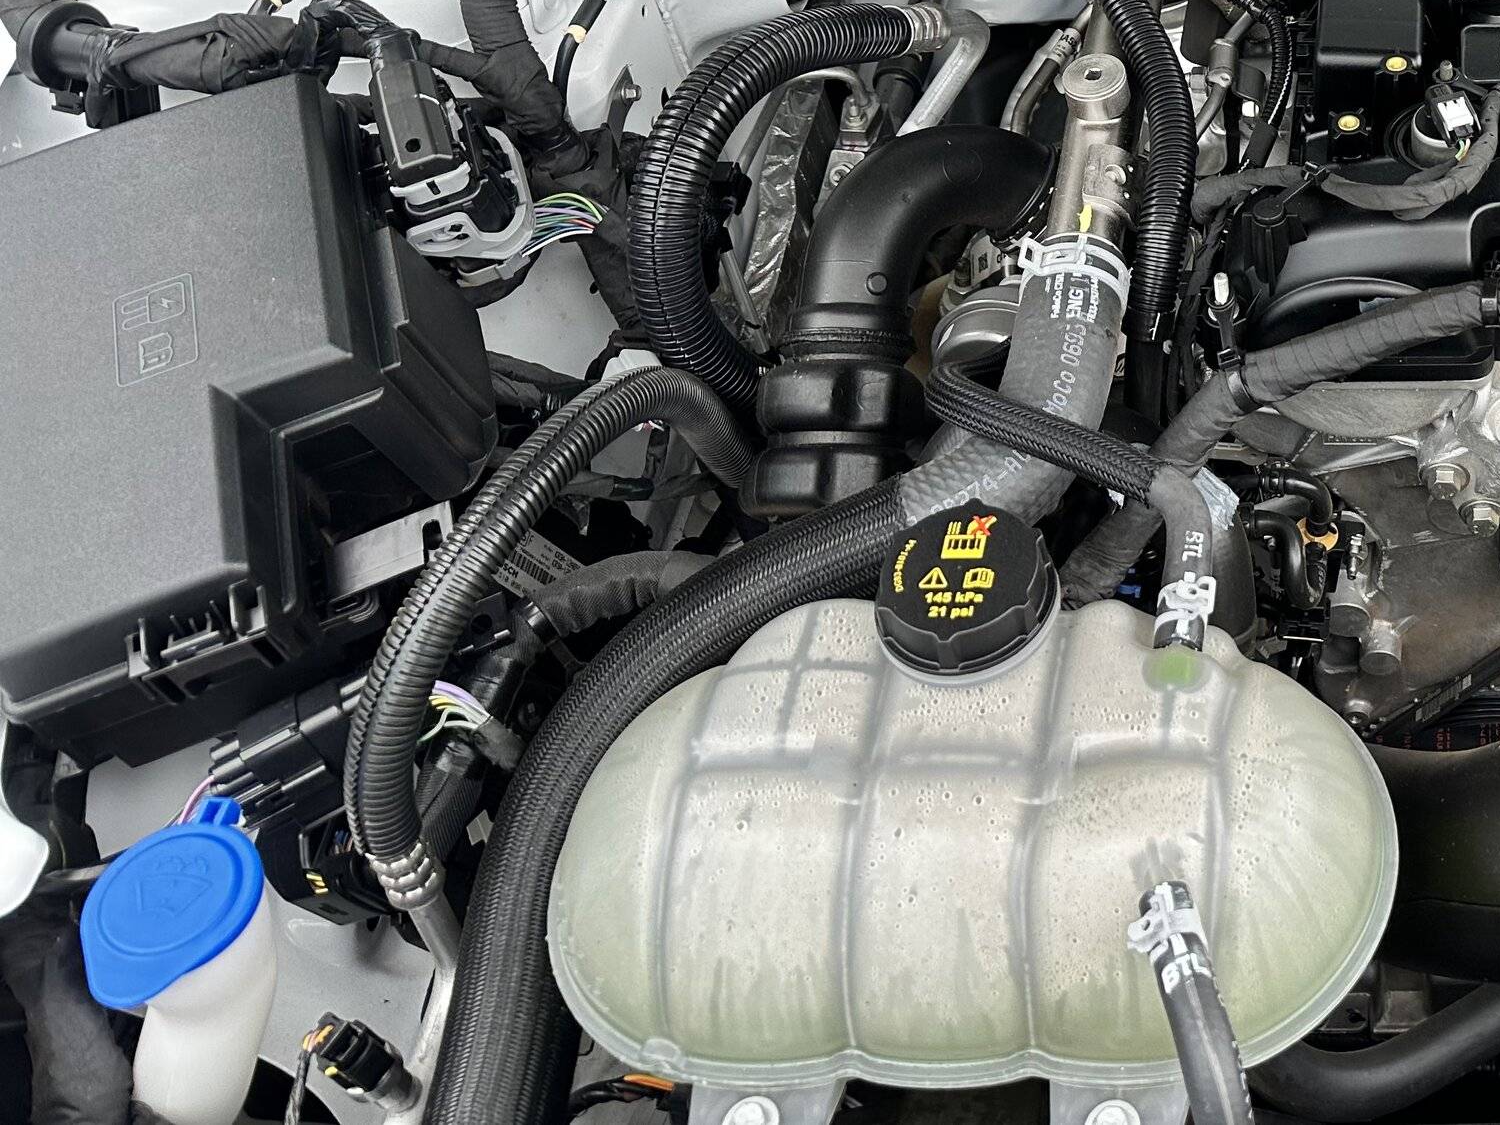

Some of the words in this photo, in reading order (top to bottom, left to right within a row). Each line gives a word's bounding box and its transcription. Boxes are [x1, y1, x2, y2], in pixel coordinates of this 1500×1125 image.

[925, 591, 953, 603] 145
[955, 591, 984, 603] kPa
[928, 605, 947, 617] 21
[950, 605, 974, 619] psi
